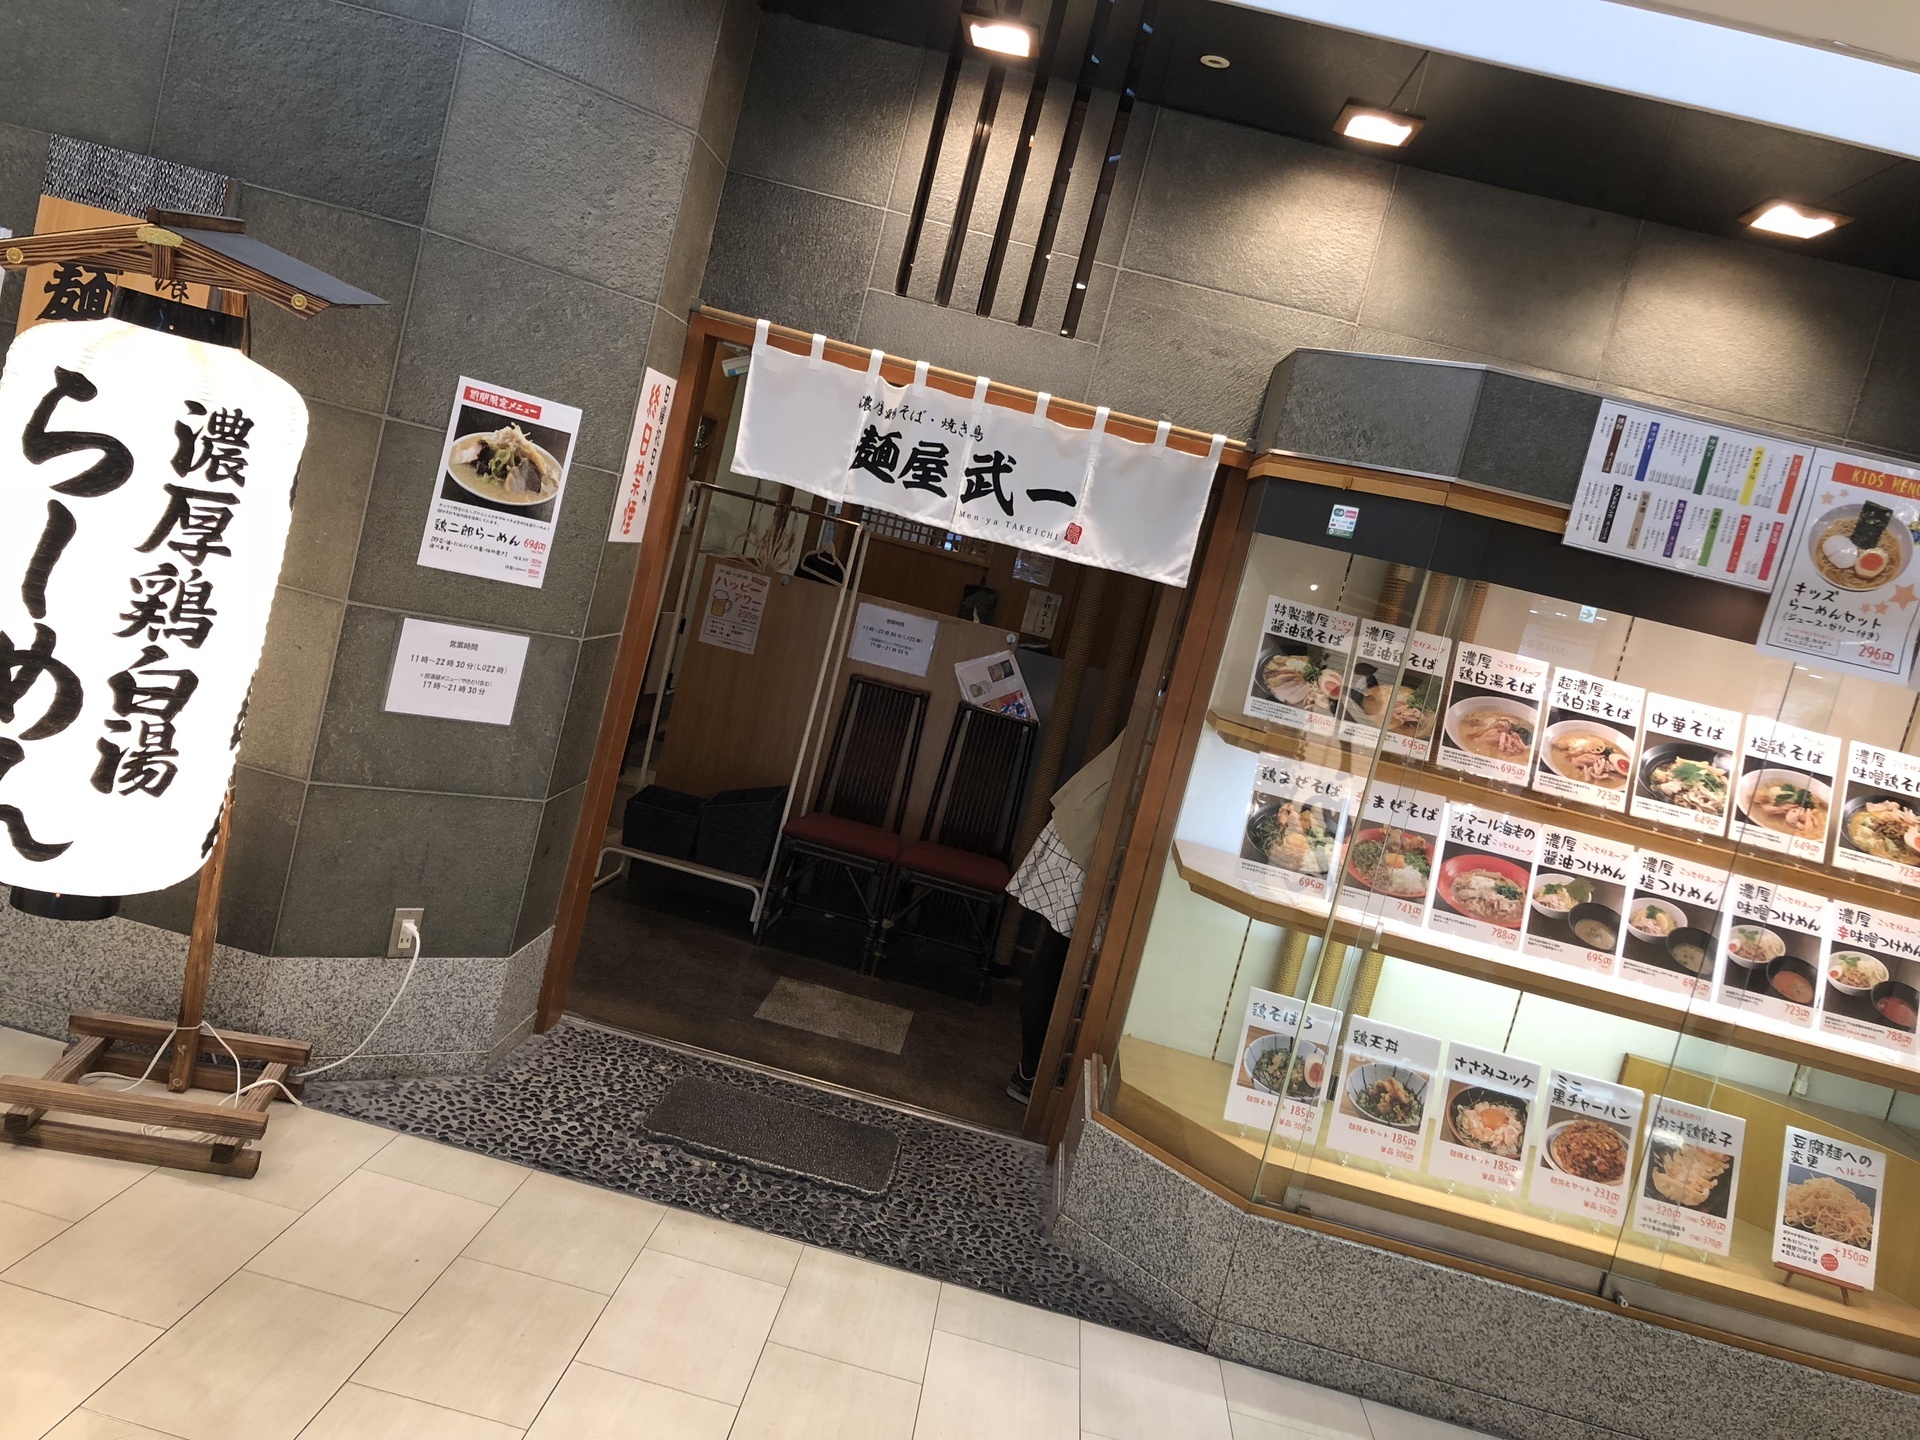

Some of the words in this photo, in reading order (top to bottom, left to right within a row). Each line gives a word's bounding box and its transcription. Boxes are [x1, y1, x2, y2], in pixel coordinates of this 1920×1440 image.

[469, 387, 538, 415] 期間限定メニュー
[849, 424, 1077, 517] 麺屋武一
[1852, 469, 1886, 488] KIDS
[434, 518, 521, 547] 鶏二郎らーめん
[1005, 520, 1059, 541] TAKEICHI
[523, 538, 547, 552] 694円
[715, 576, 762, 593] ハッピー
[1793, 581, 1840, 602] キッズ
[90, 400, 255, 798] 濃厚鶏白湯
[1273, 602, 1330, 628] 特製濃厚
[1789, 598, 1881, 629] らーめんセット
[1270, 618, 1345, 646] 醤油鶏そば
[1365, 626, 1396, 645] 濃厚
[1400, 636, 1446, 654] こてりスープ
[449, 640, 479, 651] 営業時間
[1859, 644, 1895, 663] 296円
[1462, 650, 1493, 669] 濃厚
[1497, 660, 1542, 678] こってりスープ
[1459, 666, 1537, 694] 鶏白湯そば
[1557, 675, 1604, 698] 超濃厚
[1555, 691, 1633, 720] 鶏白湯そば
[1652, 711, 1726, 740] 中華そば
[1751, 736, 1825, 765] 塩鶏そば
[1856, 749, 1886, 768] 濃厚
[1500, 763, 1526, 777] 695円
[1261, 766, 1343, 797] 鶏まぜそば
[1596, 788, 1621, 803] 723円
[1693, 812, 1719, 828] 649円
[1451, 825, 1492, 846] 鶏そば
[1492, 838, 1534, 856] こってりスープ
[1545, 832, 1577, 853] 濃厚
[1583, 843, 1628, 861] こってりスープ
[1793, 840, 1820, 854] 649円
[1543, 849, 1626, 881] 醤油つけめん
[1642, 856, 1674, 876] 濃厚
[1679, 867, 1726, 886] こってりスープ
[1298, 876, 1324, 890] 695円
[1639, 874, 1718, 905] 塩つけめん
[1739, 882, 1771, 902] 濃厚
[1776, 892, 1823, 912] こってりスープ
[1397, 902, 1422, 916] 741円
[1737, 900, 1821, 932] 味噌つけめん
[1838, 908, 1871, 928] 濃厚
[1491, 927, 1517, 942] 788円
[1586, 951, 1612, 966] 695円
[1251, 1001, 1313, 1030] 鶏そぼろ
[1784, 1003, 1810, 1018] 723円
[1353, 1029, 1400, 1054] 鶏天丼
[1886, 1029, 1912, 1044] 788円
[1454, 1056, 1535, 1088] ささみユッケ
[1556, 1074, 1583, 1092] ミニ
[1289, 1104, 1315, 1121] 185円
[1551, 1087, 1632, 1120] 黒チャーハン
[1391, 1132, 1417, 1148] 185円
[1654, 1115, 1733, 1148] 肉汁鶏餃子
[1394, 1148, 1415, 1161] 306円
[1790, 1149, 1819, 1169] 変更
[1792, 1133, 1873, 1168] 豆腐麺への
[1493, 1158, 1519, 1174] 185円
[1835, 1165, 1878, 1179] ヘルシー
[1594, 1186, 1620, 1202] 231円
[1597, 1202, 1618, 1216] 352円
[1655, 1203, 1682, 1219] 320円
[1700, 1215, 1726, 1231] 590円
[1703, 1235, 1723, 1250] 370円
